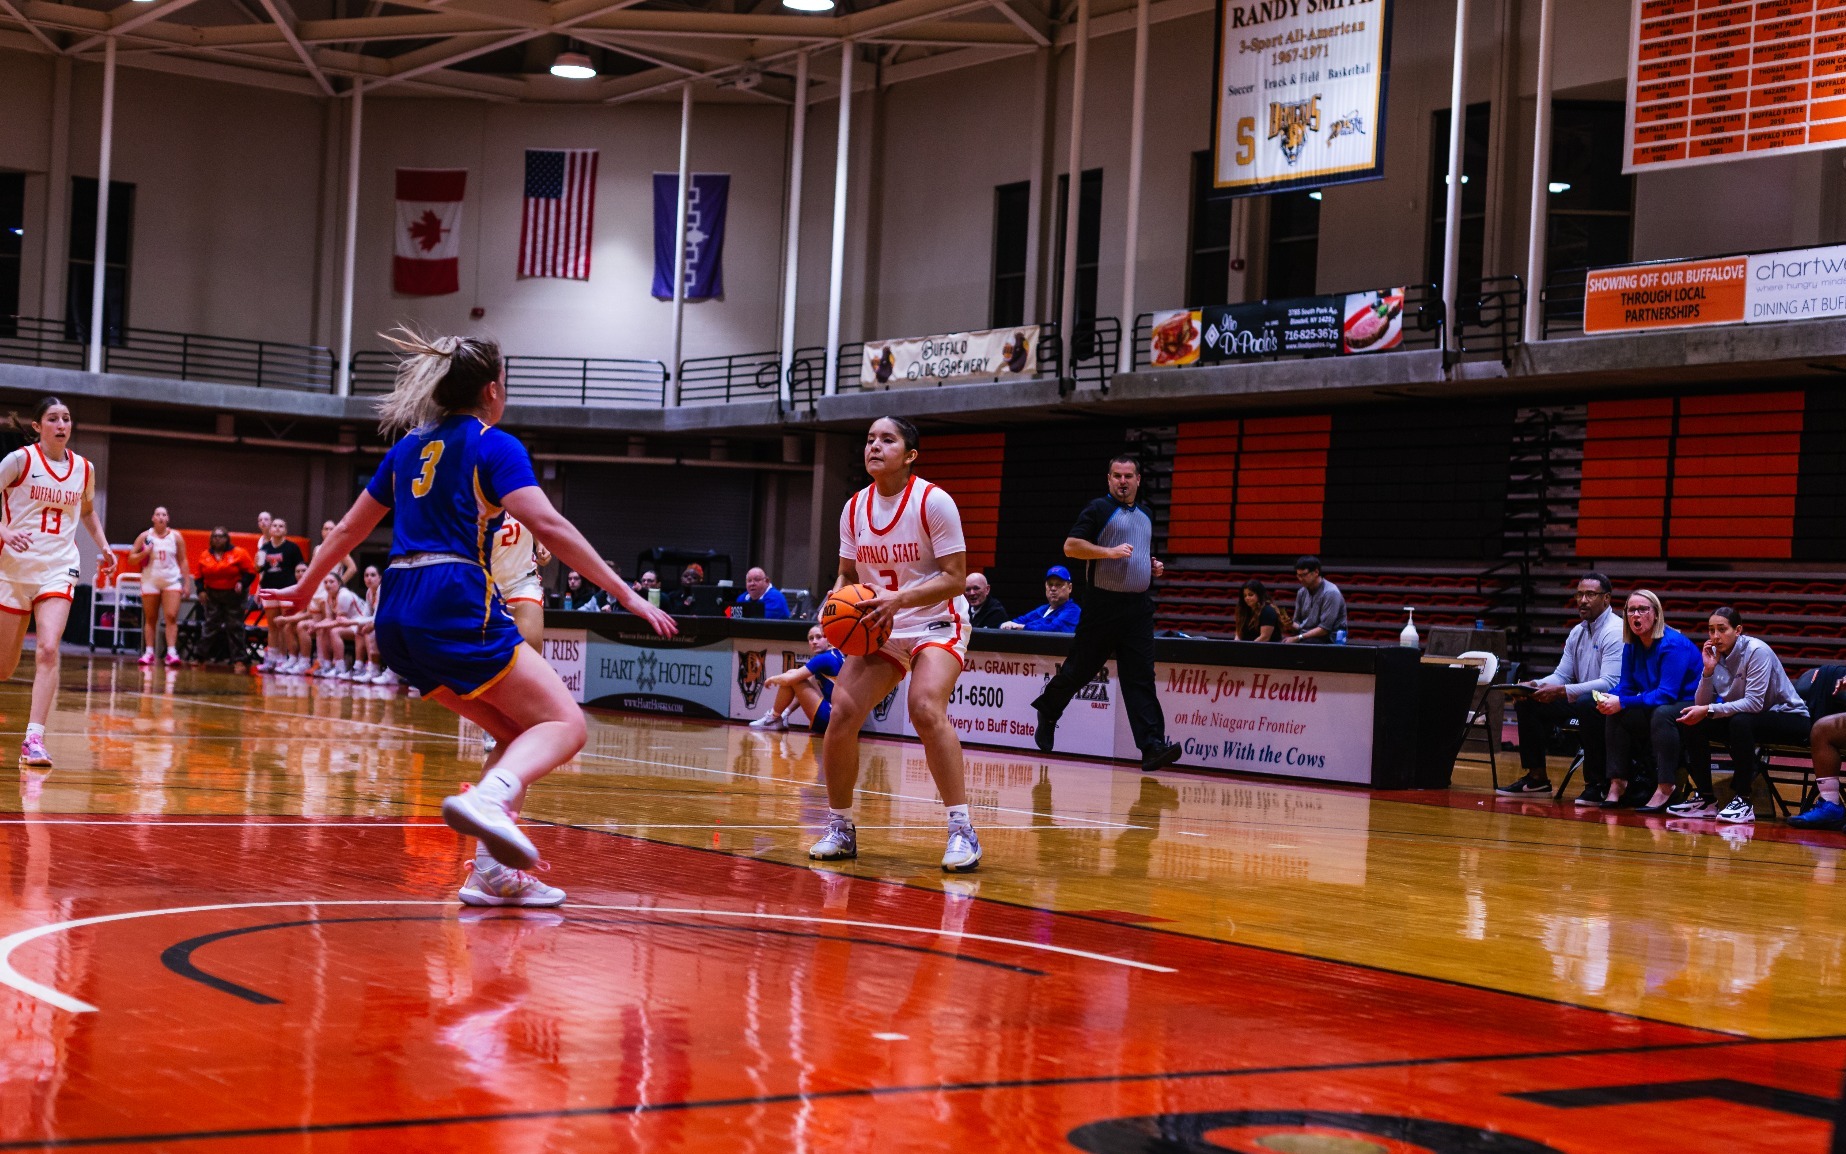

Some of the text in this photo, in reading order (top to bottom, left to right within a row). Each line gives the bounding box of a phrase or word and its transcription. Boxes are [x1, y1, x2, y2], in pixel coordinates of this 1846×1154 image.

[1232, 0, 1298, 28] RANDY
[1239, 21, 1365, 54] 3-Sport All-American
[1816, 59, 1836, 67] JOHN
[1228, 84, 1254, 96] Soccer
[1290, 74, 1296, 84] &
[1328, 63, 1370, 79] Basketball
[1815, 79, 1846, 89] BUFFALO
[1752, 106, 1804, 119] BUFFALO STATE
[1236, 116, 1255, 166] S
[1751, 128, 1803, 142] BUFFALO STATE
[1589, 264, 1745, 293] SHOWING OFF OUR BUFFALOVE
[1621, 286, 1706, 306] THROUGH LOCAL
[1625, 304, 1700, 323] PARTNERSHIPS
[1754, 300, 1798, 317] DINING
[1802, 298, 1818, 312] AT
[1285, 328, 1339, 341] 716-825-3675
[921, 339, 968, 361] BUFFALO
[937, 356, 990, 379] BREWERY
[411, 439, 446, 498] 3
[30, 484, 62, 504] BUFFALO
[41, 506, 63, 535] 13
[501, 522, 520, 547] 21
[892, 542, 921, 563] STATE
[552, 639, 579, 661] RIBS
[600, 658, 713, 688] HART HOTELS
[985, 660, 1021, 676] GRANT
[1023, 664, 1037, 677] ST.
[1165, 668, 1318, 704] Milk for Health
[975, 718, 984, 731] to
[987, 718, 1009, 734] Buff
[1010, 720, 1035, 737] State
[1175, 709, 1307, 736] on the Niagara Frontier
[1184, 737, 1219, 761] Guys
[1223, 740, 1255, 761] With
[1259, 744, 1283, 763] the
[1286, 747, 1326, 769] Cows
